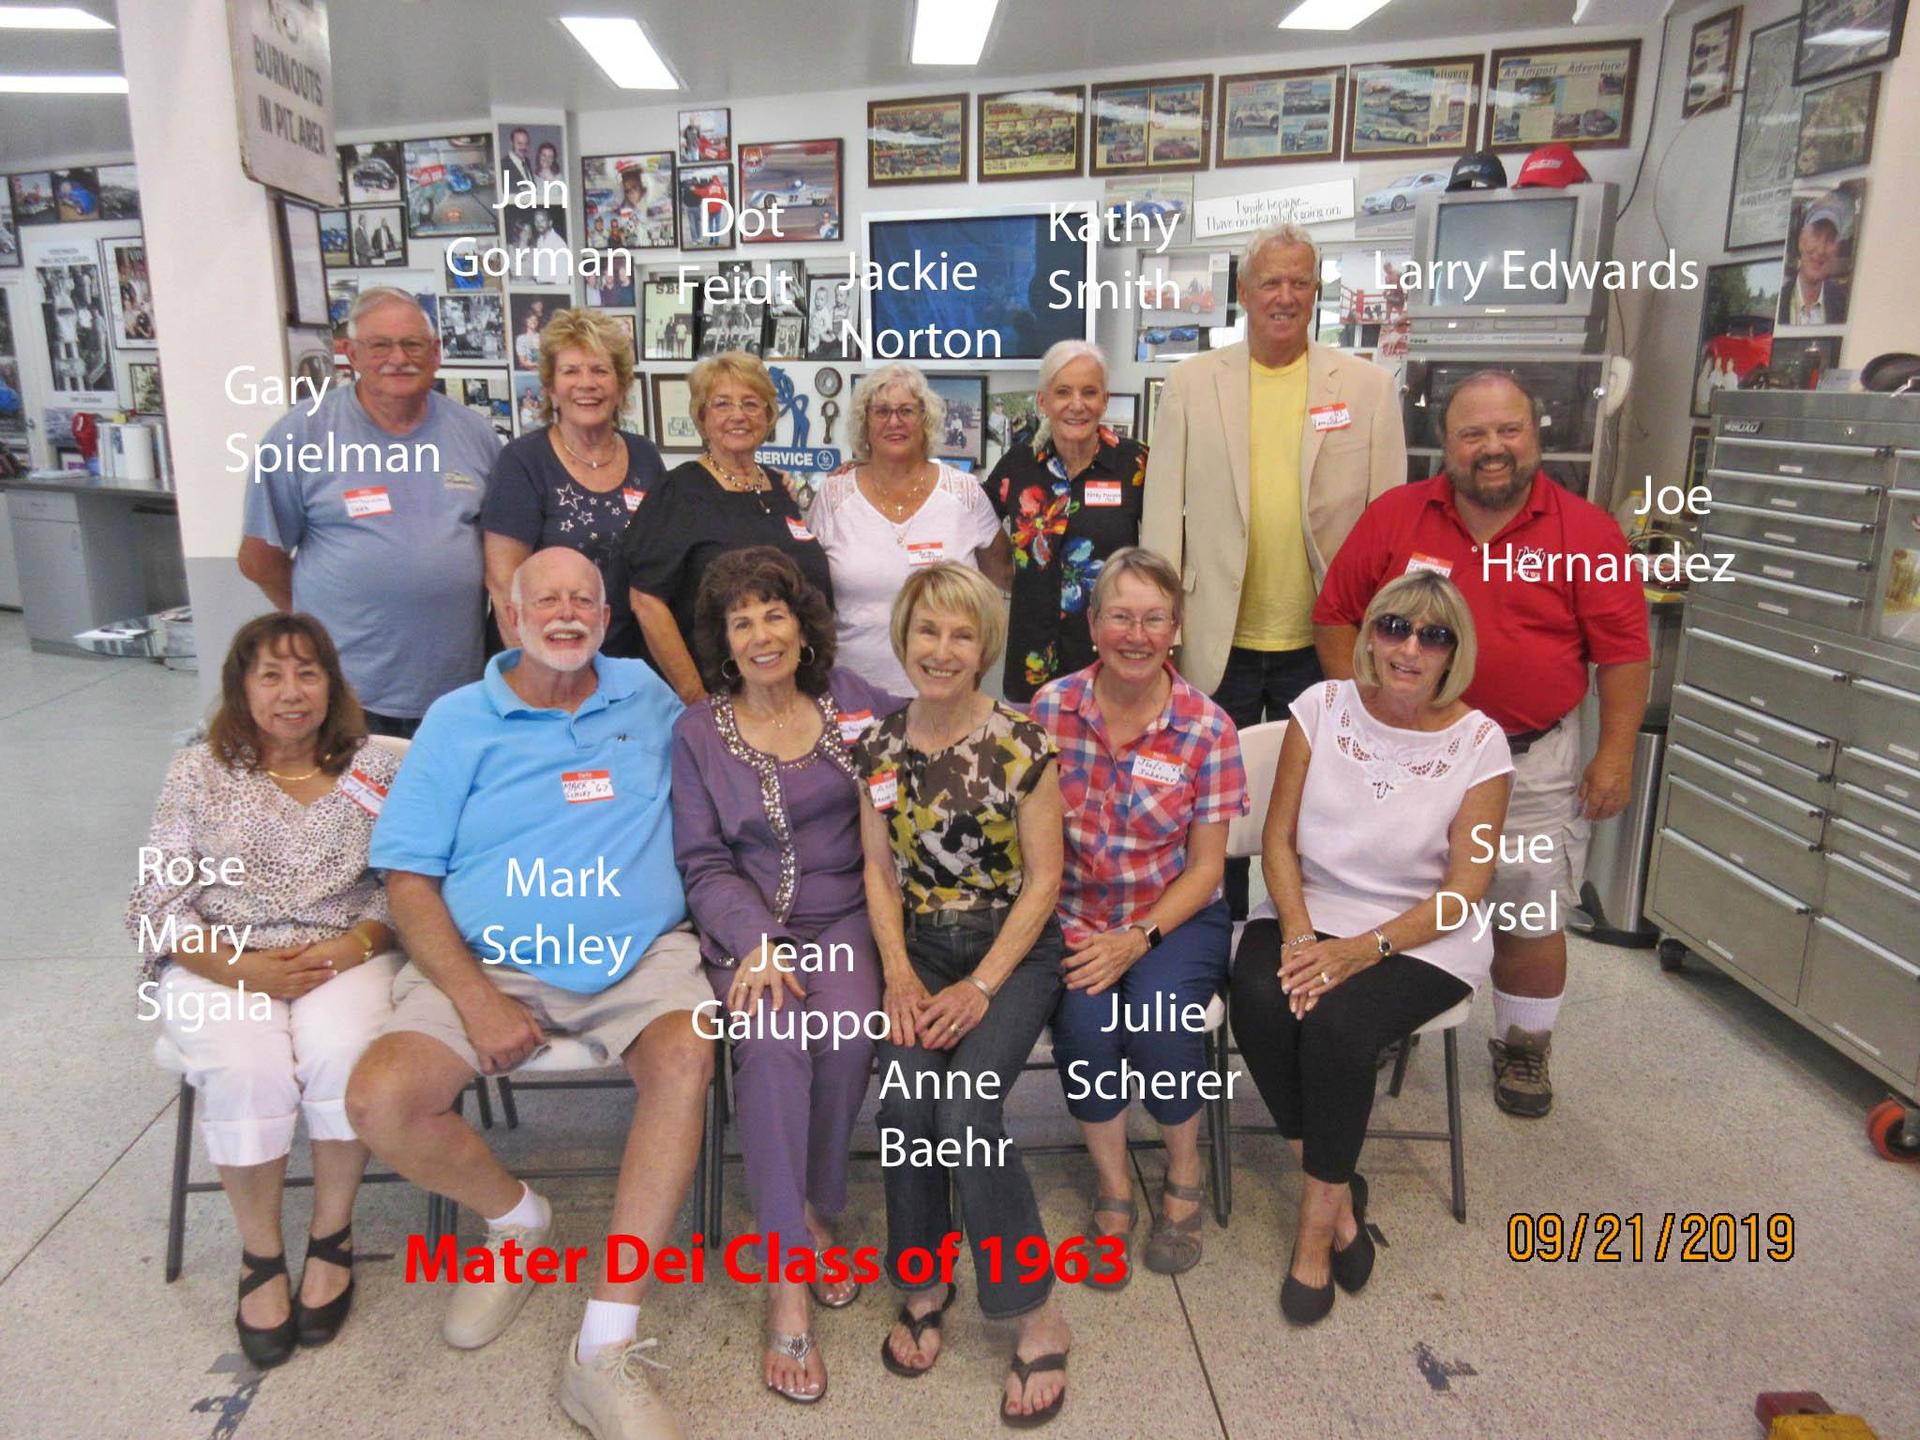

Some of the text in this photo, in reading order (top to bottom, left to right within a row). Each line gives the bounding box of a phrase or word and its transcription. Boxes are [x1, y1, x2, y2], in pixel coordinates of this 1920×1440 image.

[253, 34, 324, 107] BURNOUTS
[1523, 64, 1557, 78] Import
[258, 94, 327, 156] IN PIT AREA
[1242, 199, 1264, 214] smile
[1212, 215, 1233, 230] have
[1235, 218, 1248, 227] no
[1250, 212, 1269, 226] idea
[754, 450, 814, 467] SERVICE
